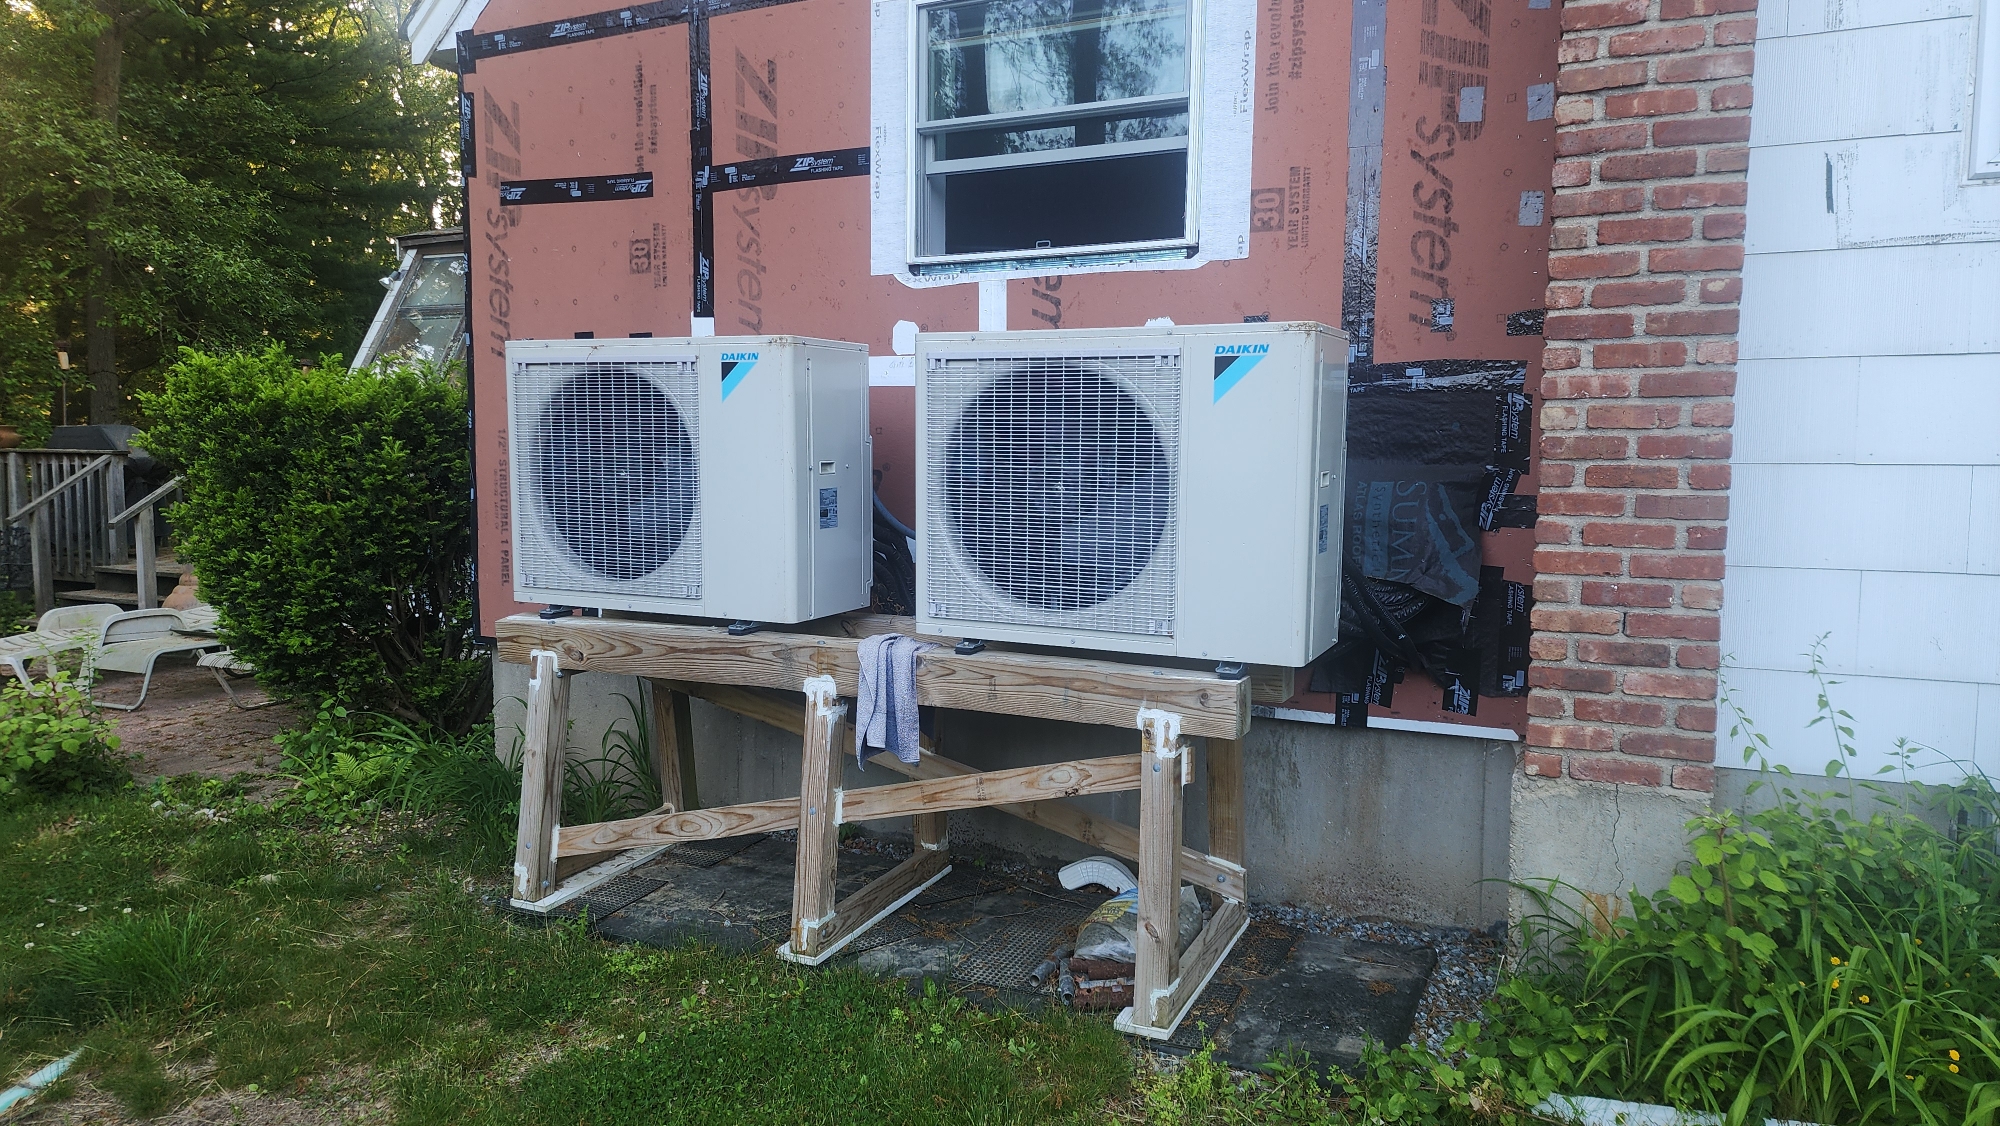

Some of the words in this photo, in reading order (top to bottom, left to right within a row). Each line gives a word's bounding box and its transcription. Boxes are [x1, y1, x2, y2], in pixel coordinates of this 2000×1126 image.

[1288, 0, 1306, 80] #zipsyste
[1240, 29, 1251, 114] FlexWrap
[1266, 52, 1280, 77] the
[1265, 83, 1280, 115] Join
[874, 126, 882, 200] FlexWrap
[1288, 166, 1301, 215] SYSTEM
[1302, 166, 1311, 213] WARRANTY
[1252, 192, 1281, 229] 30
[1287, 219, 1299, 251] YEAR
[1301, 214, 1309, 249] LIMITED
[631, 240, 650, 273] 30
[721, 352, 760, 361] DAIKIN
[1214, 343, 1270, 355] DAIKIN
[1350, 386, 1366, 394] TAPE
[499, 459, 509, 535] STRUCTURAL
[1353, 481, 1368, 521] ATLAS
[501, 550, 510, 587] PANEL
[1364, 676, 1373, 704] FLASHING
